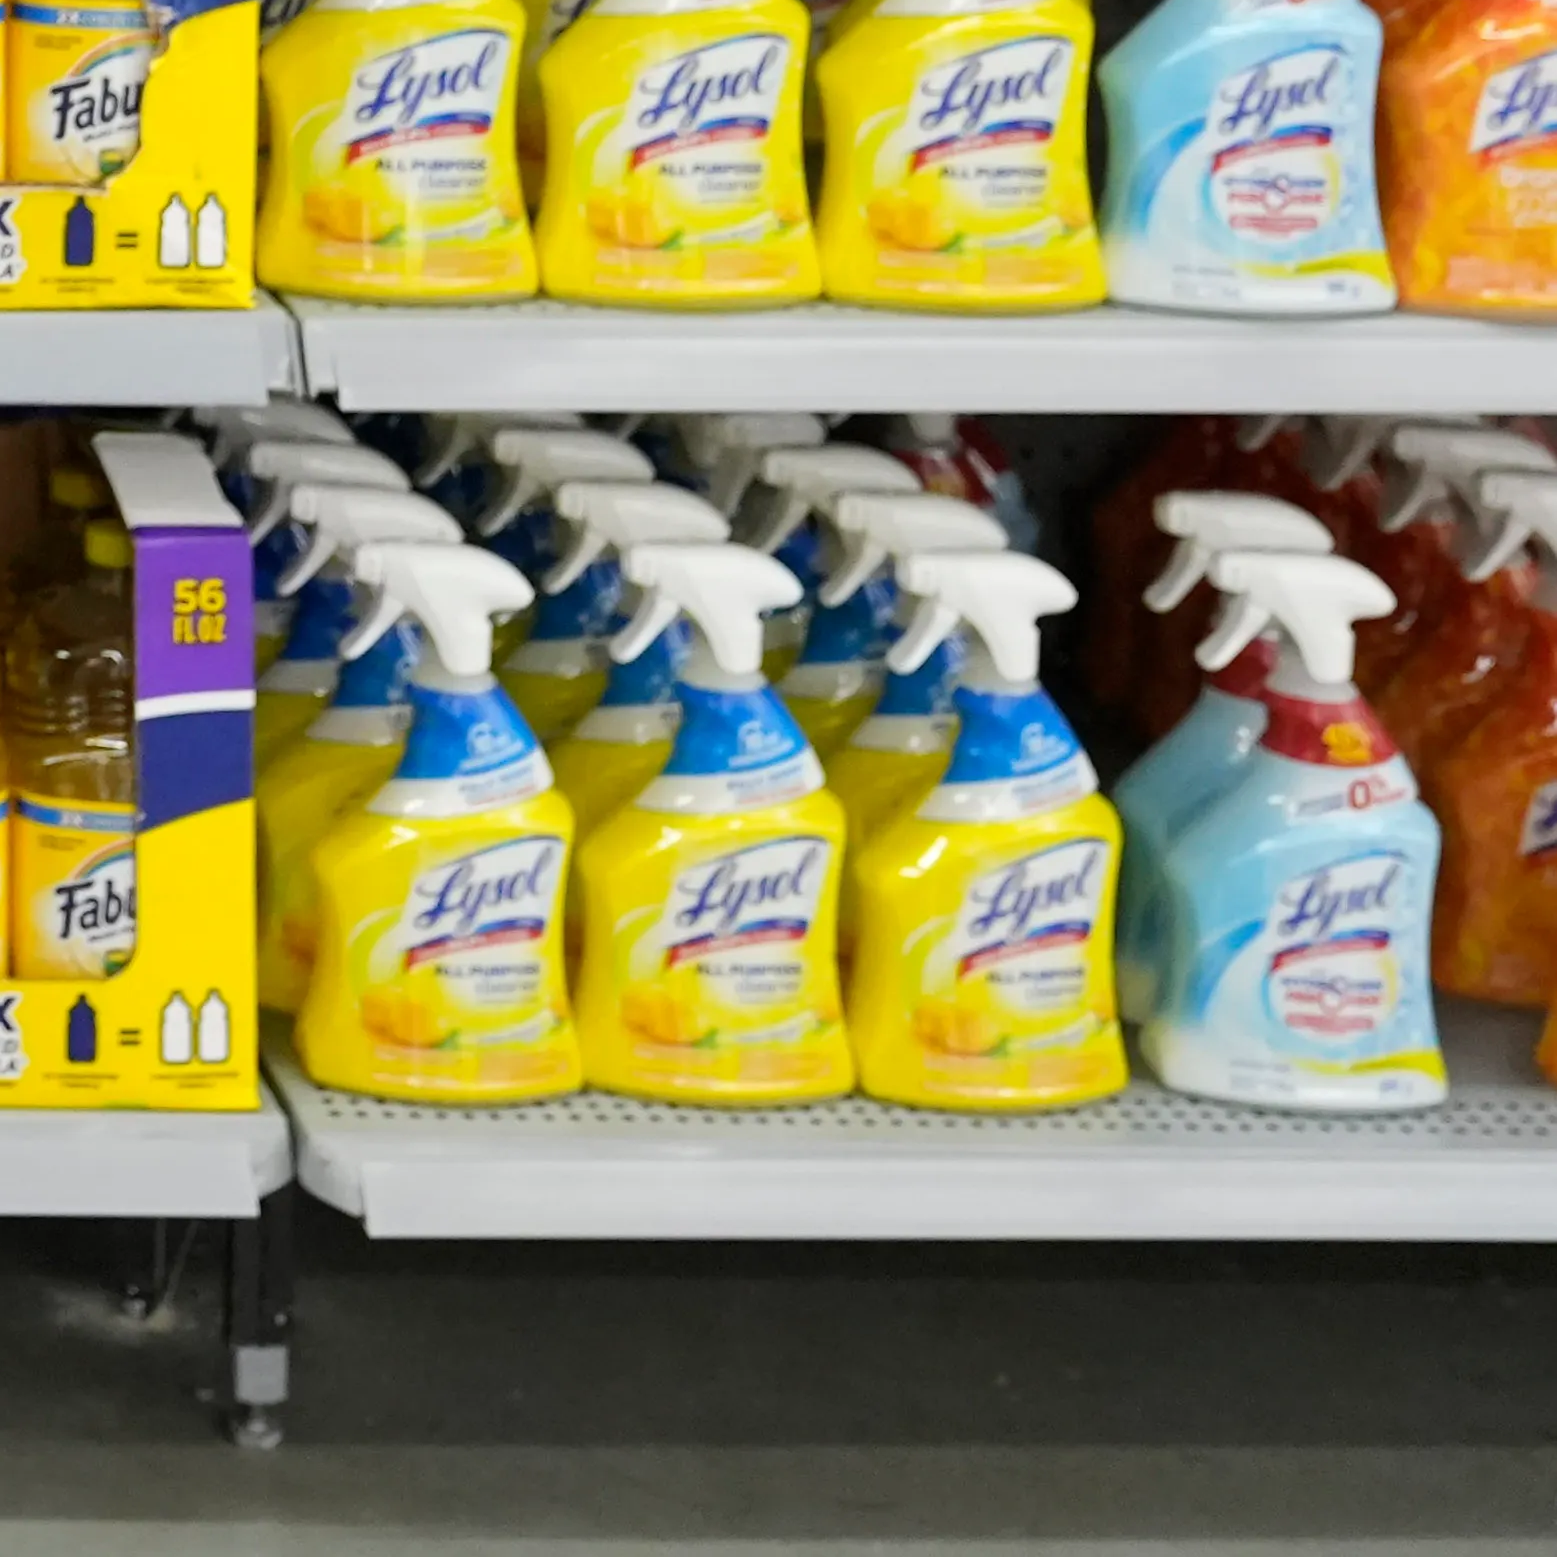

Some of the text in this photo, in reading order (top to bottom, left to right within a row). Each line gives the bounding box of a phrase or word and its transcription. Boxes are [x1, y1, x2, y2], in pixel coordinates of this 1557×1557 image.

[50, 81, 140, 141] Fabu
[355, 40, 499, 126] Lysol
[637, 45, 782, 131] Lysol
[919, 44, 1067, 130] Lysol
[1220, 57, 1334, 139] Lysol
[173, 578, 227, 614] 56
[173, 615, 227, 644] FL OZ
[54, 880, 137, 939] Fabu
[413, 845, 556, 936] Lysol
[675, 844, 820, 934] Lysol
[969, 855, 1105, 942] Lysol
[1280, 859, 1405, 939] Lysol
